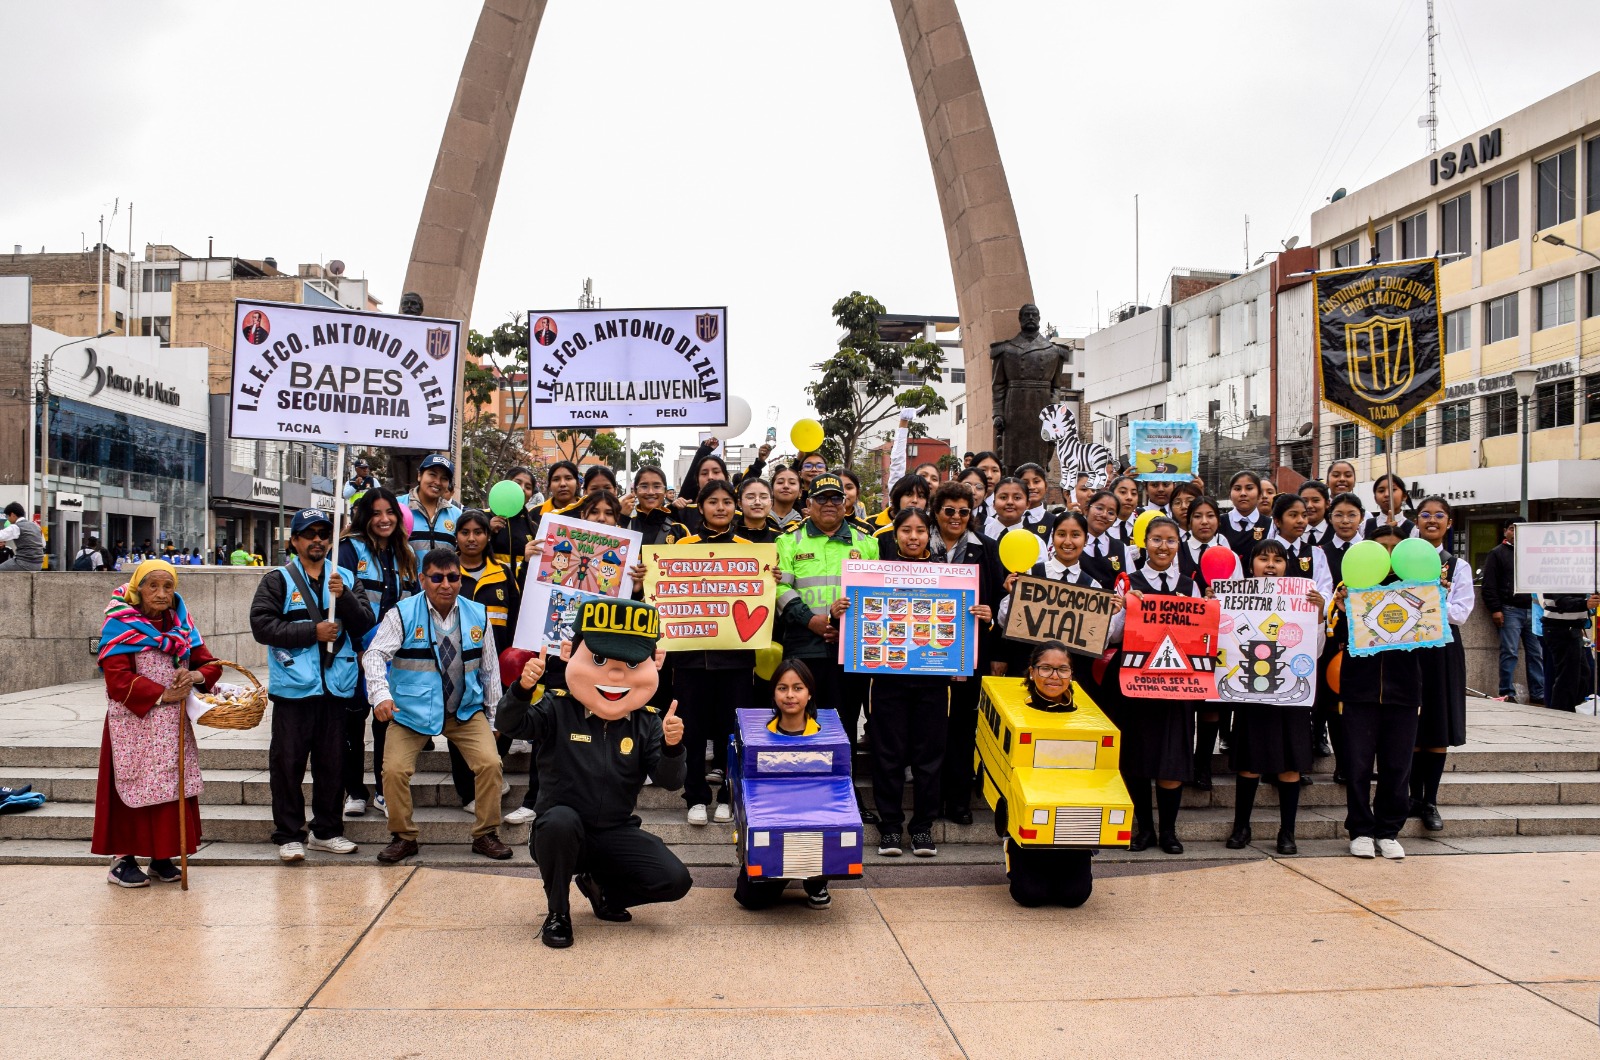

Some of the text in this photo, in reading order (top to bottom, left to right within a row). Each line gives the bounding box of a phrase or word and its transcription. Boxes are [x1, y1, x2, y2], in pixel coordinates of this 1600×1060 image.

[1430, 127, 1502, 186] ISAM
[1319, 275, 1433, 316] INSTITUCIÓN EDUCATIVA
[1341, 289, 1412, 317] EMBLEMÁTICA
[594, 318, 675, 345] ANTONIO
[674, 335, 701, 362] DE
[692, 357, 721, 403] ZELA
[106, 365, 132, 392] Banco
[134, 375, 144, 396] de
[145, 378, 154, 398] la
[289, 361, 403, 396] BAPES
[313, 322, 403, 359] ANTONIO
[401, 349, 429, 379] DE
[418, 375, 447, 426] ZELA
[554, 379, 707, 403] PATRULLA JUVENIL
[277, 389, 410, 418] SECUNDARIA
[569, 410, 609, 419] TACNA
[656, 407, 687, 418] PERÚ
[1368, 405, 1400, 420] TACNA
[277, 422, 321, 435] TACNA
[375, 428, 409, 440] PERÚ
[262, 485, 280, 497] movista
[815, 477, 841, 489] POLICIA
[556, 527, 620, 548] LA SEGURIDAD
[577, 542, 595, 555] VIAL
[727, 562, 757, 573] POR
[847, 563, 973, 576] EDUCACION VIAL TAREA
[658, 578, 763, 595] LAS LÍNEAS Y
[884, 576, 937, 585] DE TODOS
[1213, 579, 1259, 594] RESPETAR
[1020, 582, 1110, 615] EDUCACIÓN
[1223, 595, 1273, 611] RESPETAR
[658, 603, 727, 616] CUIDA TU
[1141, 600, 1206, 615] NO IGNORES
[582, 602, 659, 634] POLICIA
[1143, 612, 1157, 624] LA
[1024, 605, 1087, 648] VIAL
[1126, 682, 1160, 692] ÚLTIMA
[1134, 674, 1166, 684] PODRÍA
[1188, 677, 1200, 685] LA
